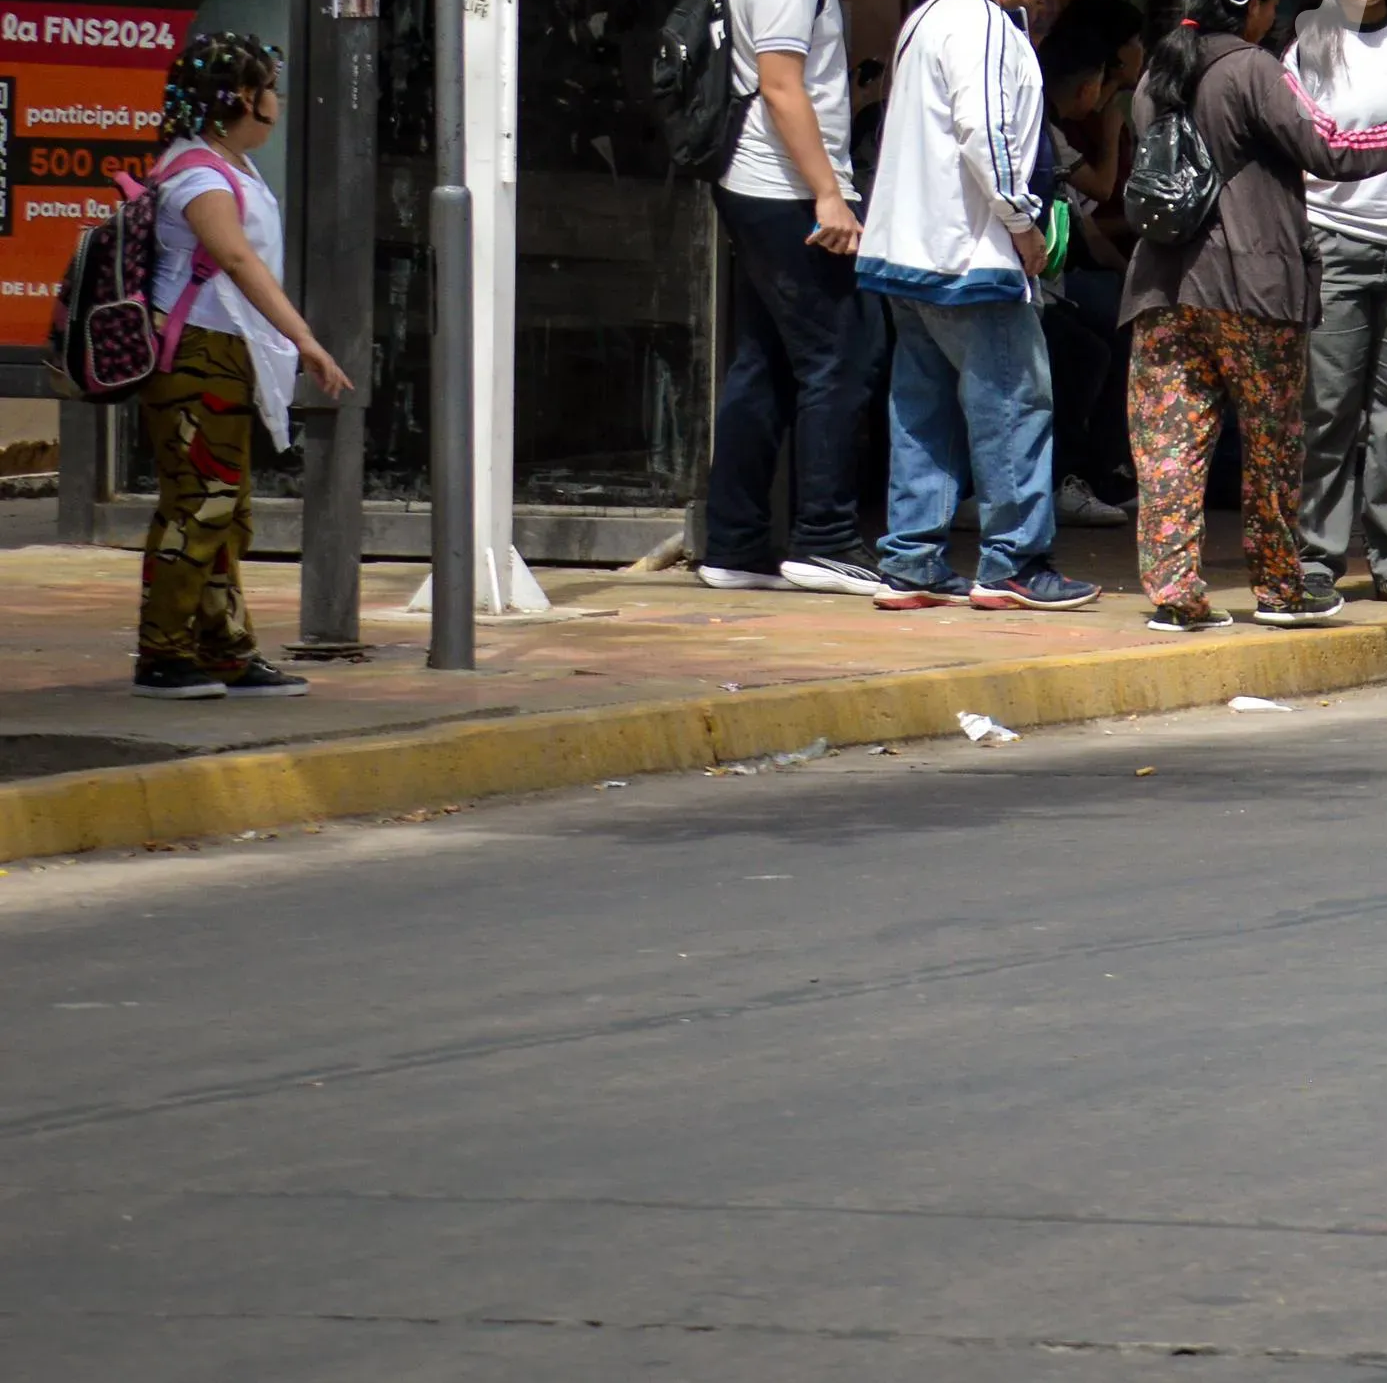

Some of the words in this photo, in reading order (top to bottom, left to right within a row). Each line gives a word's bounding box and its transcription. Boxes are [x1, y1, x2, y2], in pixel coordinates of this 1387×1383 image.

[2, 12, 38, 43] la
[44, 15, 176, 50] FNS2024
[26, 105, 129, 130] participá
[134, 108, 165, 130] po
[30, 148, 93, 177] 500
[25, 201, 82, 221] para
[1, 281, 24, 296] DE
[27, 282, 49, 297] LA
